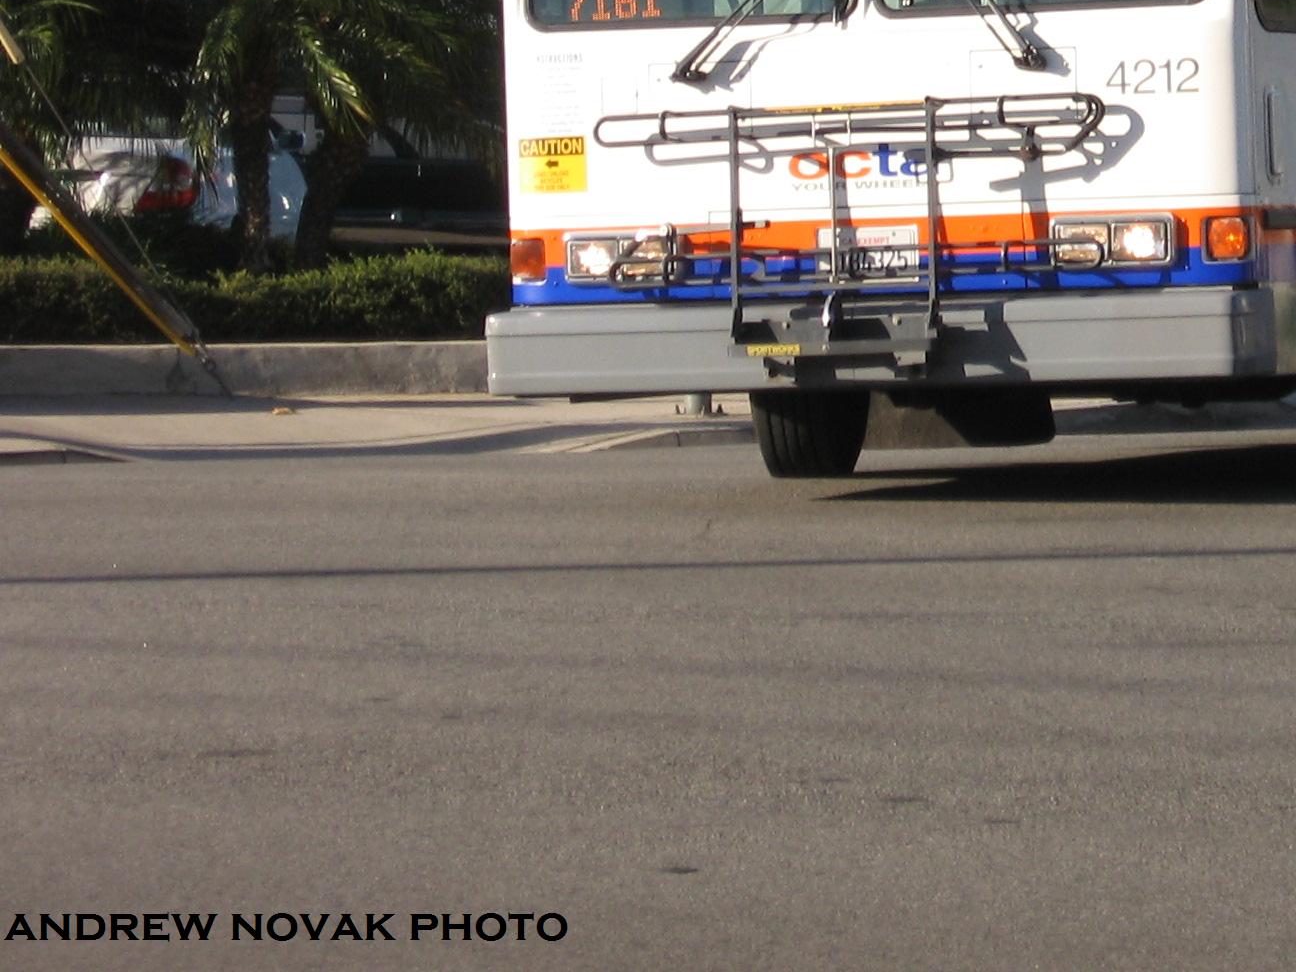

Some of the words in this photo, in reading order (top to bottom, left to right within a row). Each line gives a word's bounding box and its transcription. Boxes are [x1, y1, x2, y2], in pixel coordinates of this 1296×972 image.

[1106, 57, 1200, 95] 4212
[520, 138, 583, 156] CAUTION
[788, 143, 930, 180] octa
[854, 178, 932, 189] WHEEL
